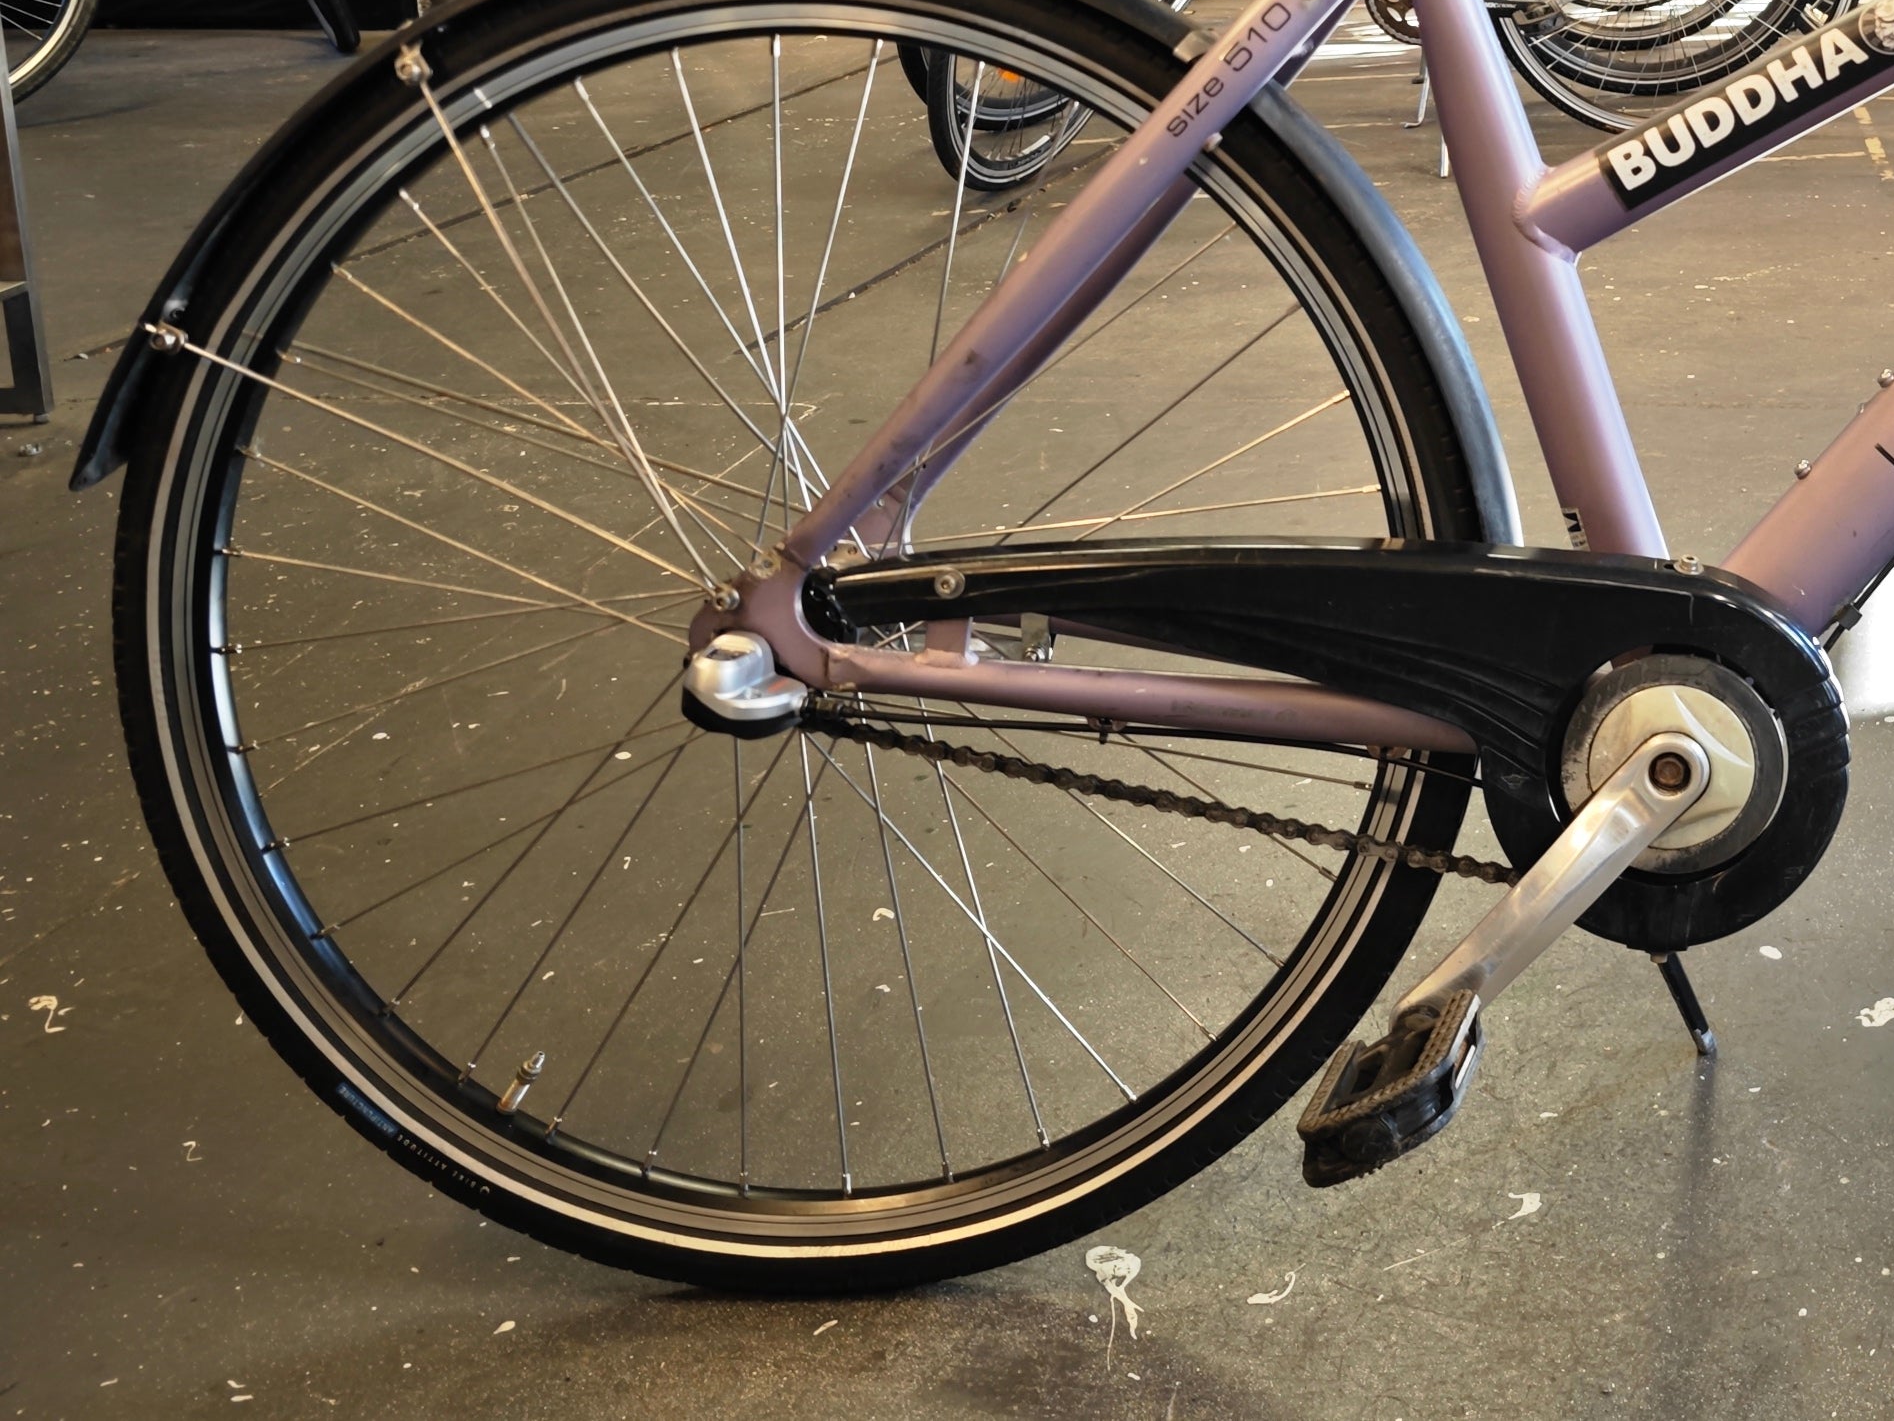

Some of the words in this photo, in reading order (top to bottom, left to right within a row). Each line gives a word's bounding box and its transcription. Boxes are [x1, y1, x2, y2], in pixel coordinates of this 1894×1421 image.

[1223, 2, 1292, 72] 510
[1606, 28, 1868, 193] BUDDHA
[338, 1086, 394, 1133] ANTIPUNCTURE
[397, 1134, 447, 1170] ATTITUDE
